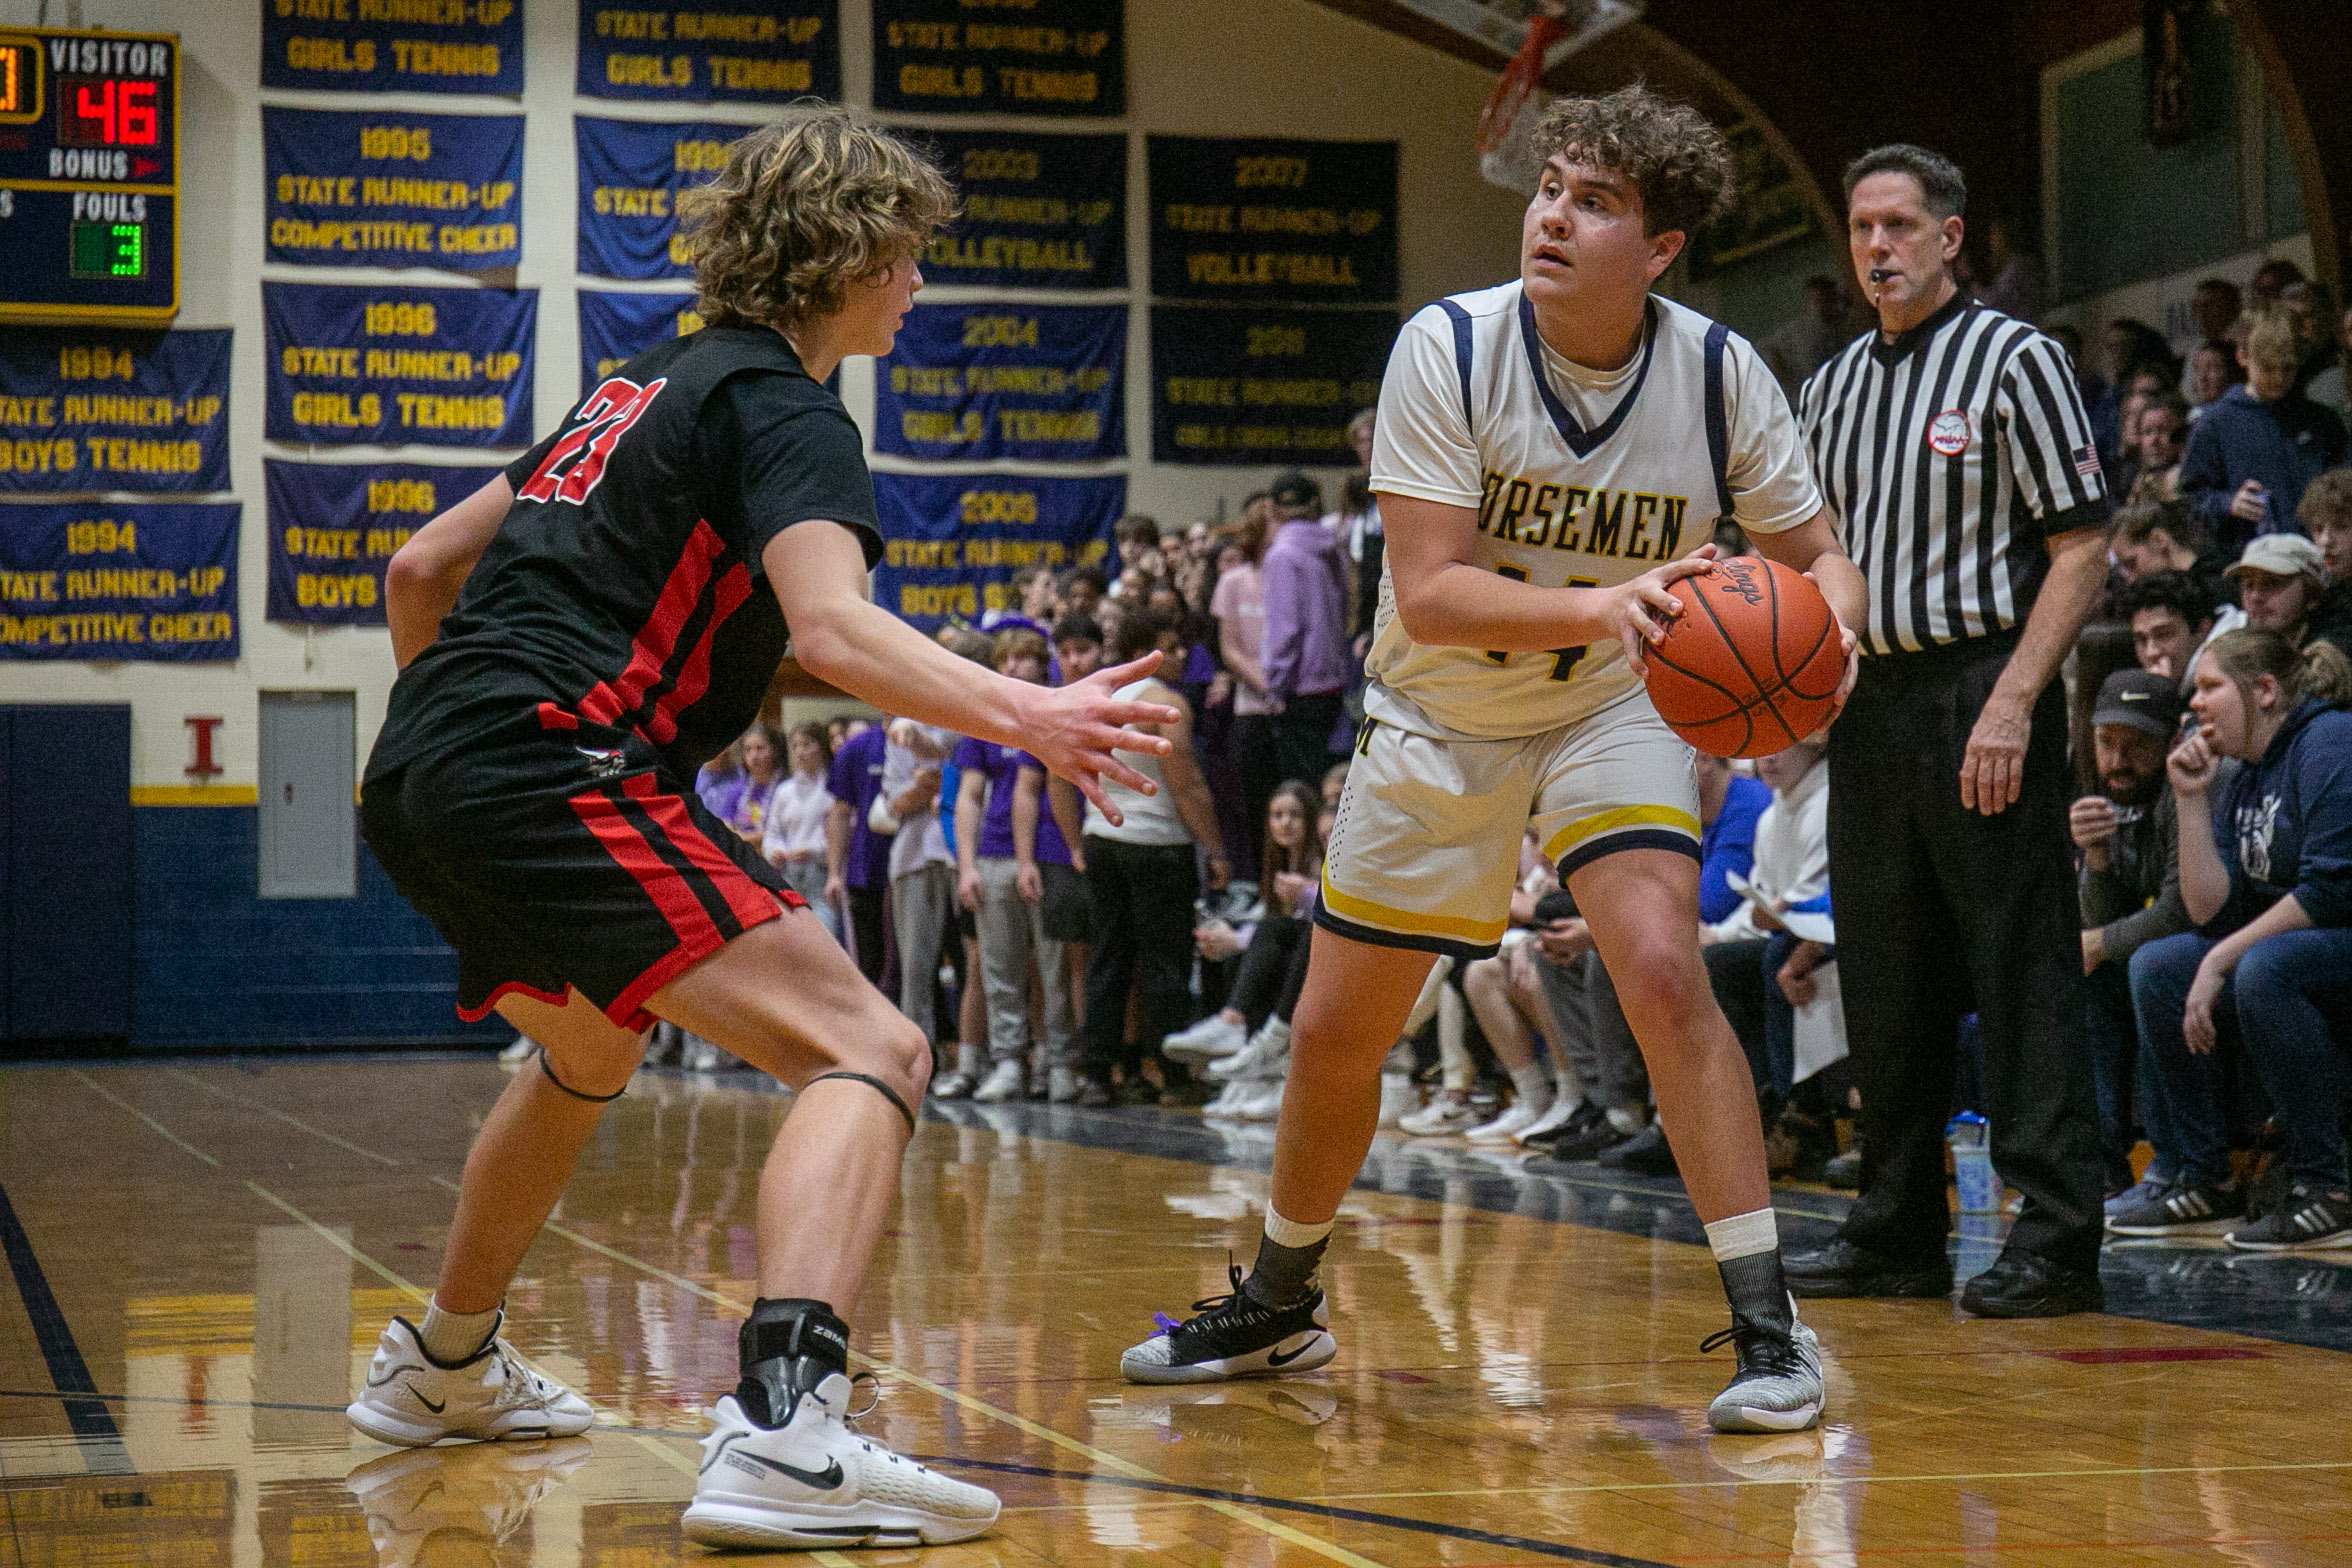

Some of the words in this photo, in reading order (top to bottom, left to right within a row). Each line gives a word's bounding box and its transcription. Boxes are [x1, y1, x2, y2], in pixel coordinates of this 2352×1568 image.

[52, 38, 167, 77] VISITOR
[287, 37, 376, 71] GIRLS
[392, 40, 499, 76] TENNIS
[606, 53, 692, 87] GIRLS
[707, 56, 811, 90] TENNIS
[78, 80, 156, 145] 46
[50, 148, 128, 180] BONUS
[73, 191, 147, 222] FOULS
[277, 174, 356, 206] STATE
[362, 177, 515, 209] RUNNER-UP
[593, 186, 670, 217] STATE
[112, 225, 141, 276] 3
[271, 218, 433, 251] COMPETITIVE
[439, 224, 517, 253] CHEER
[365, 302, 436, 336] 1996
[59, 347, 133, 381] 1994
[282, 346, 358, 378] STATE
[365, 349, 520, 380] RUNNER-UP
[63, 395, 220, 426] RUNNER-UP
[292, 391, 381, 427] GIRLS
[396, 392, 505, 429] TENNIS
[86, 436, 201, 474] TENNIS
[1478, 470, 1689, 563] ORSEMEN
[66, 519, 136, 555] 1994
[285, 526, 358, 559] STATE
[66, 566, 226, 599] RUNNER-UP
[297, 573, 377, 607] BOYS
[151, 611, 233, 643] CHEER
